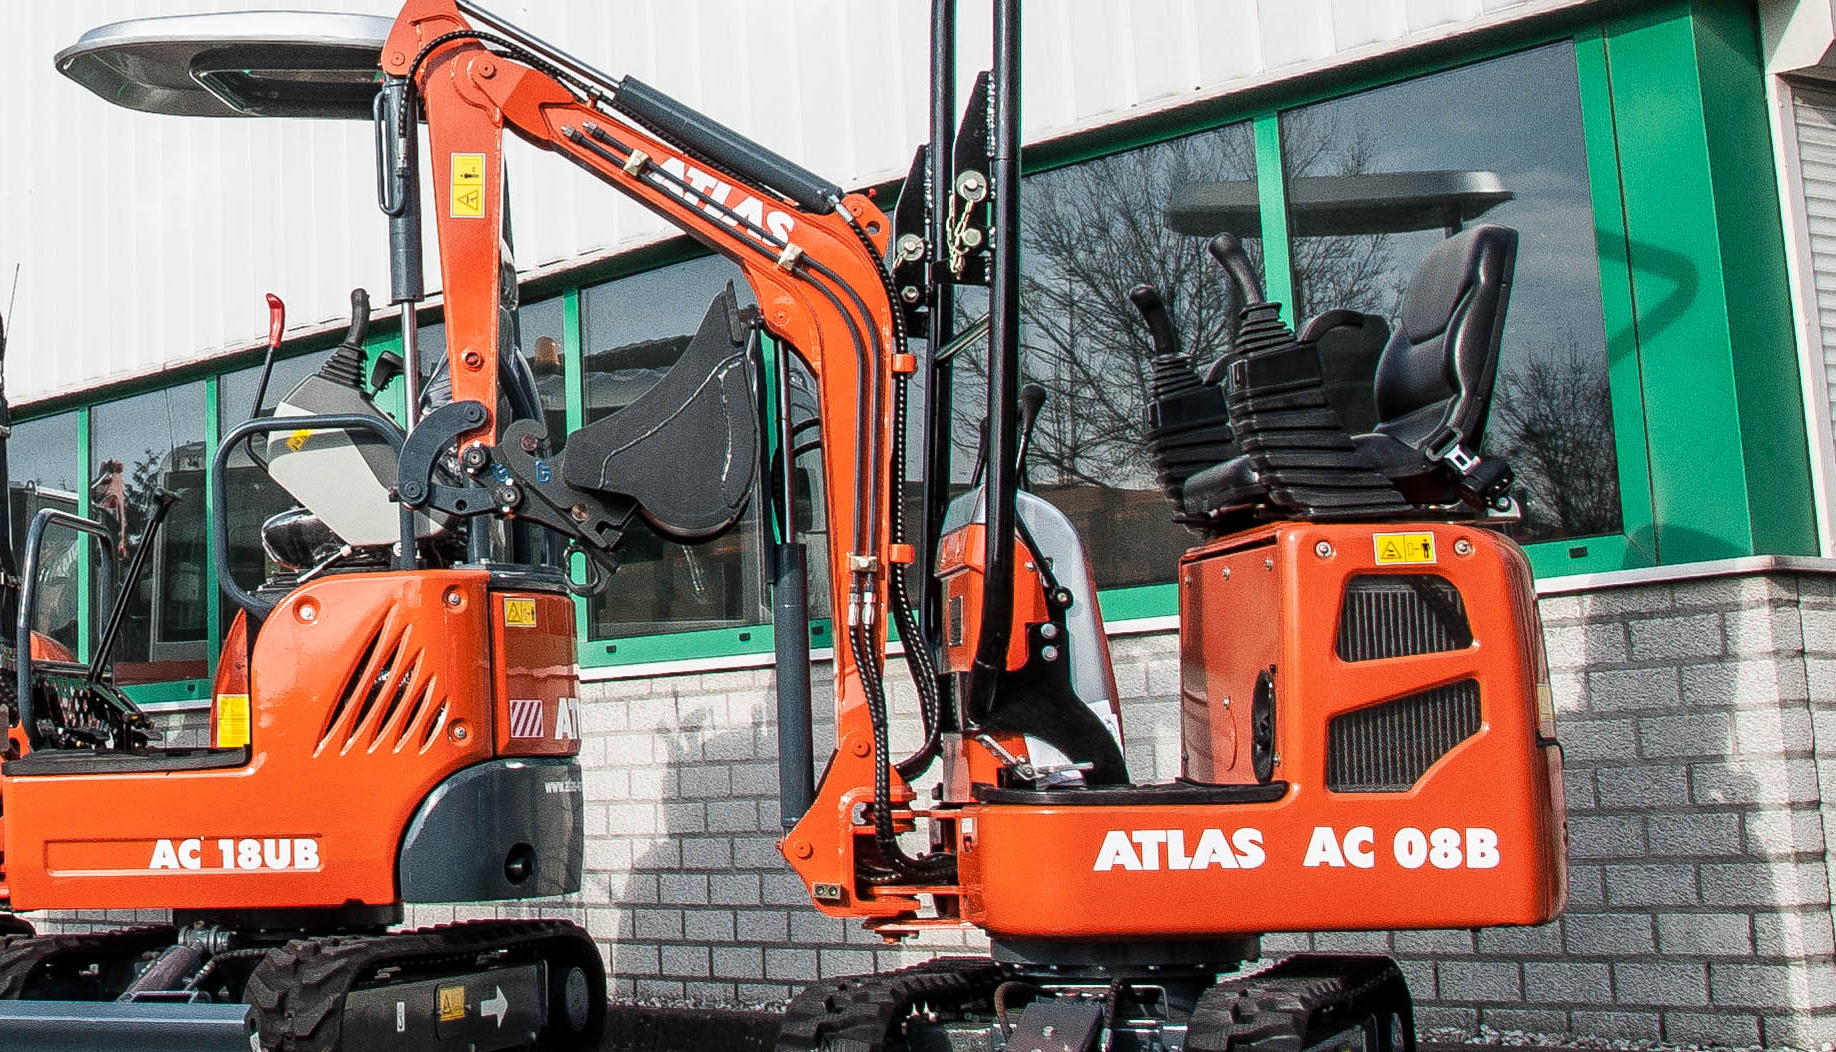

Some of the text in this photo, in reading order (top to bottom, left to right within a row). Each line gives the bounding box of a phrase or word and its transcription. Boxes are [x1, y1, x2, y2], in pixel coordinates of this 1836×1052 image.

[649, 157, 795, 247] ATLAS
[148, 838, 320, 870] AC 18UB
[1092, 826, 1501, 872] ATLAS AC 08B
